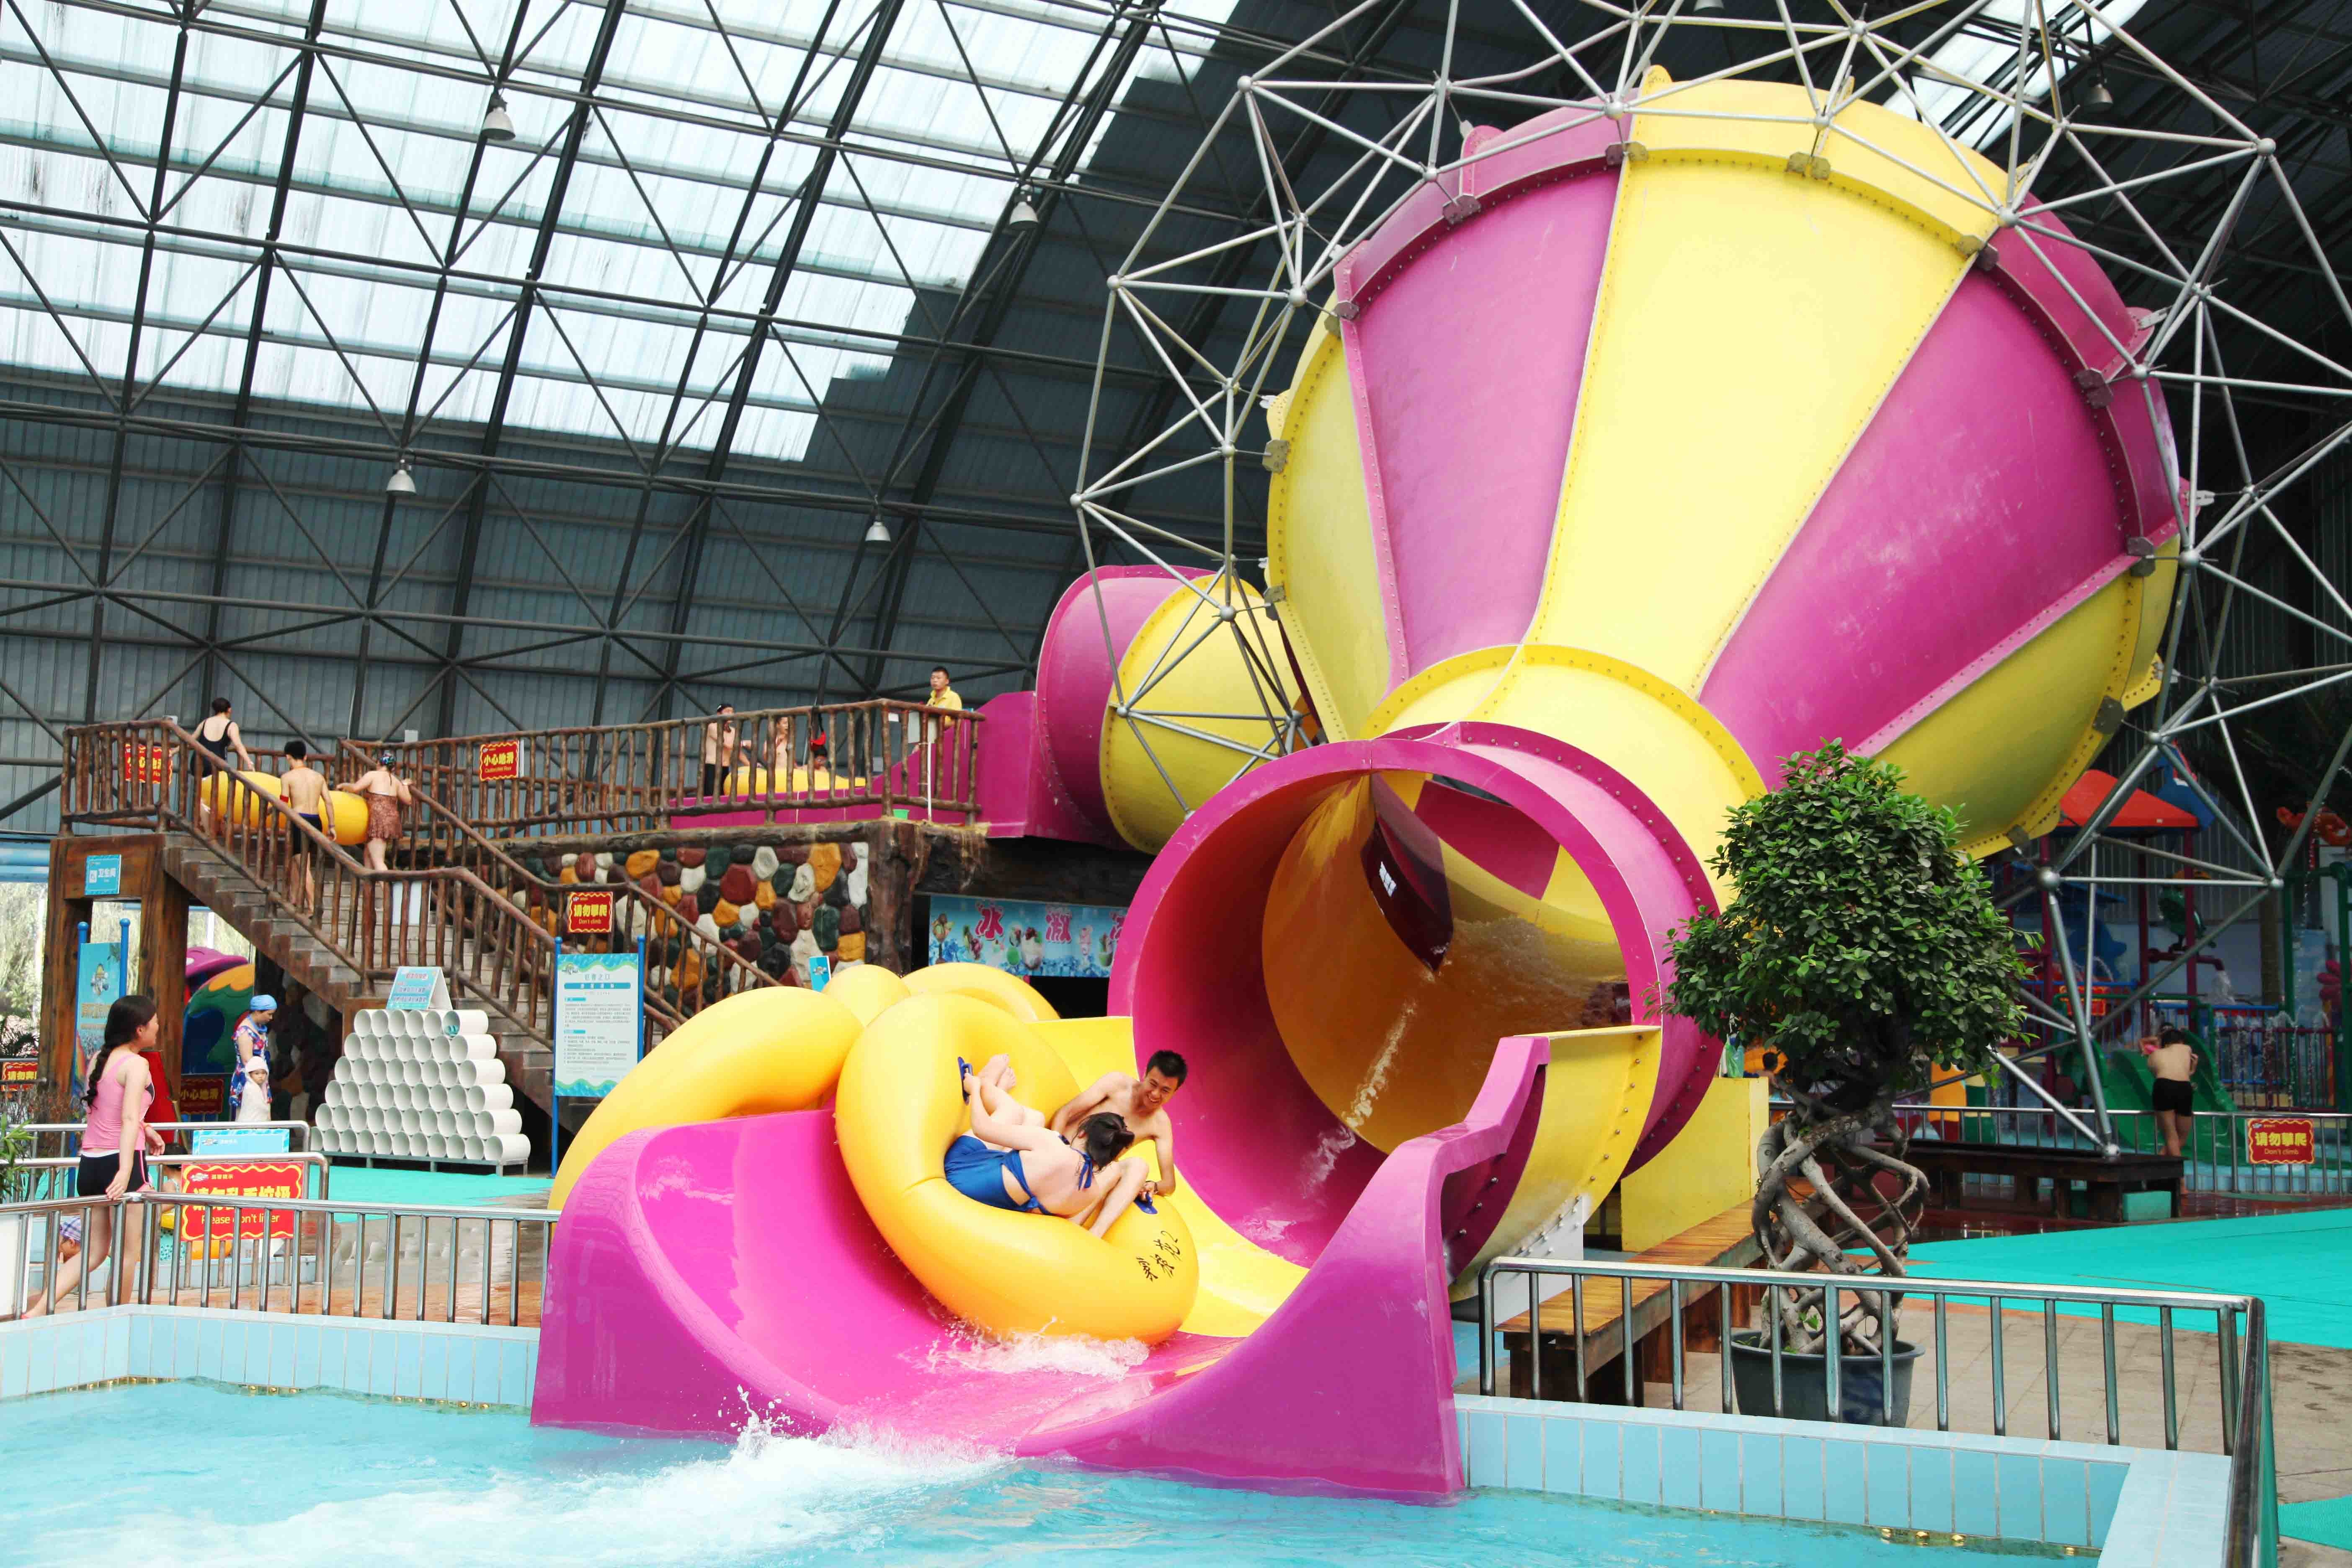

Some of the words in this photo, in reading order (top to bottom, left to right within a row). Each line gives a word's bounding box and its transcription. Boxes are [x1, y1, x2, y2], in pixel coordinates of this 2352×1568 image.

[484, 752, 514, 766] 小心地滑
[2255, 1132, 2307, 1147] 请勿攀爬
[259, 1213, 280, 1222] lier
